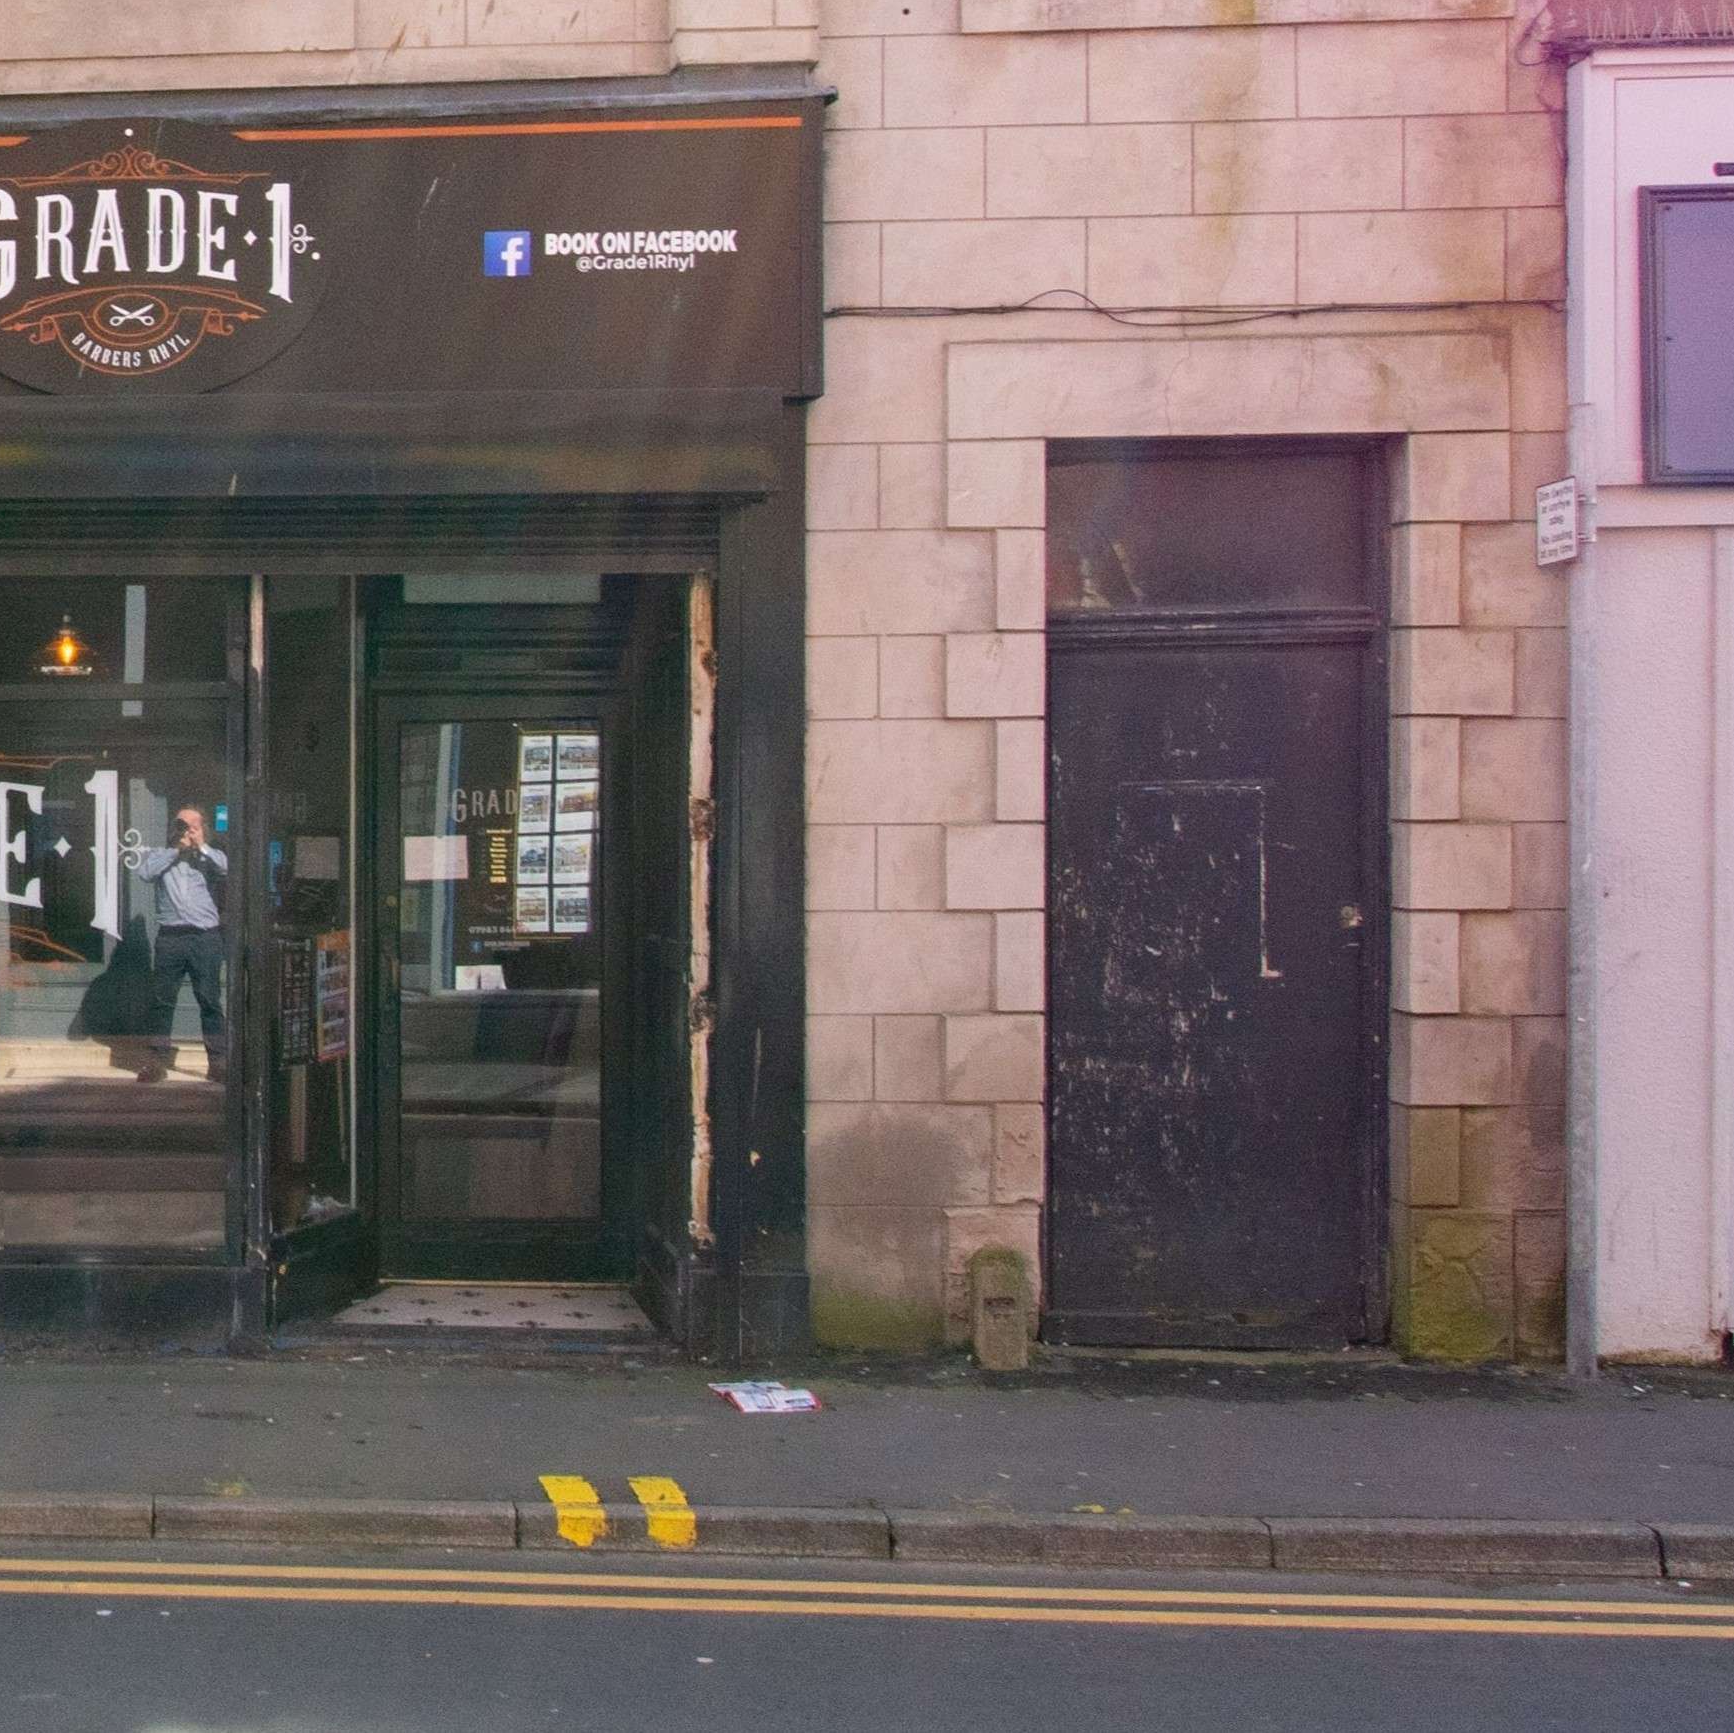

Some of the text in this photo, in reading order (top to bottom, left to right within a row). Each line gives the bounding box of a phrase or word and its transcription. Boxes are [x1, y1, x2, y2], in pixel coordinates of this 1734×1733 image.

[544, 229, 739, 255] BOOK ON FACEBOOK
[575, 253, 696, 273] @Grade1Rhyl
[71, 332, 191, 367] BARBERS RHYL
